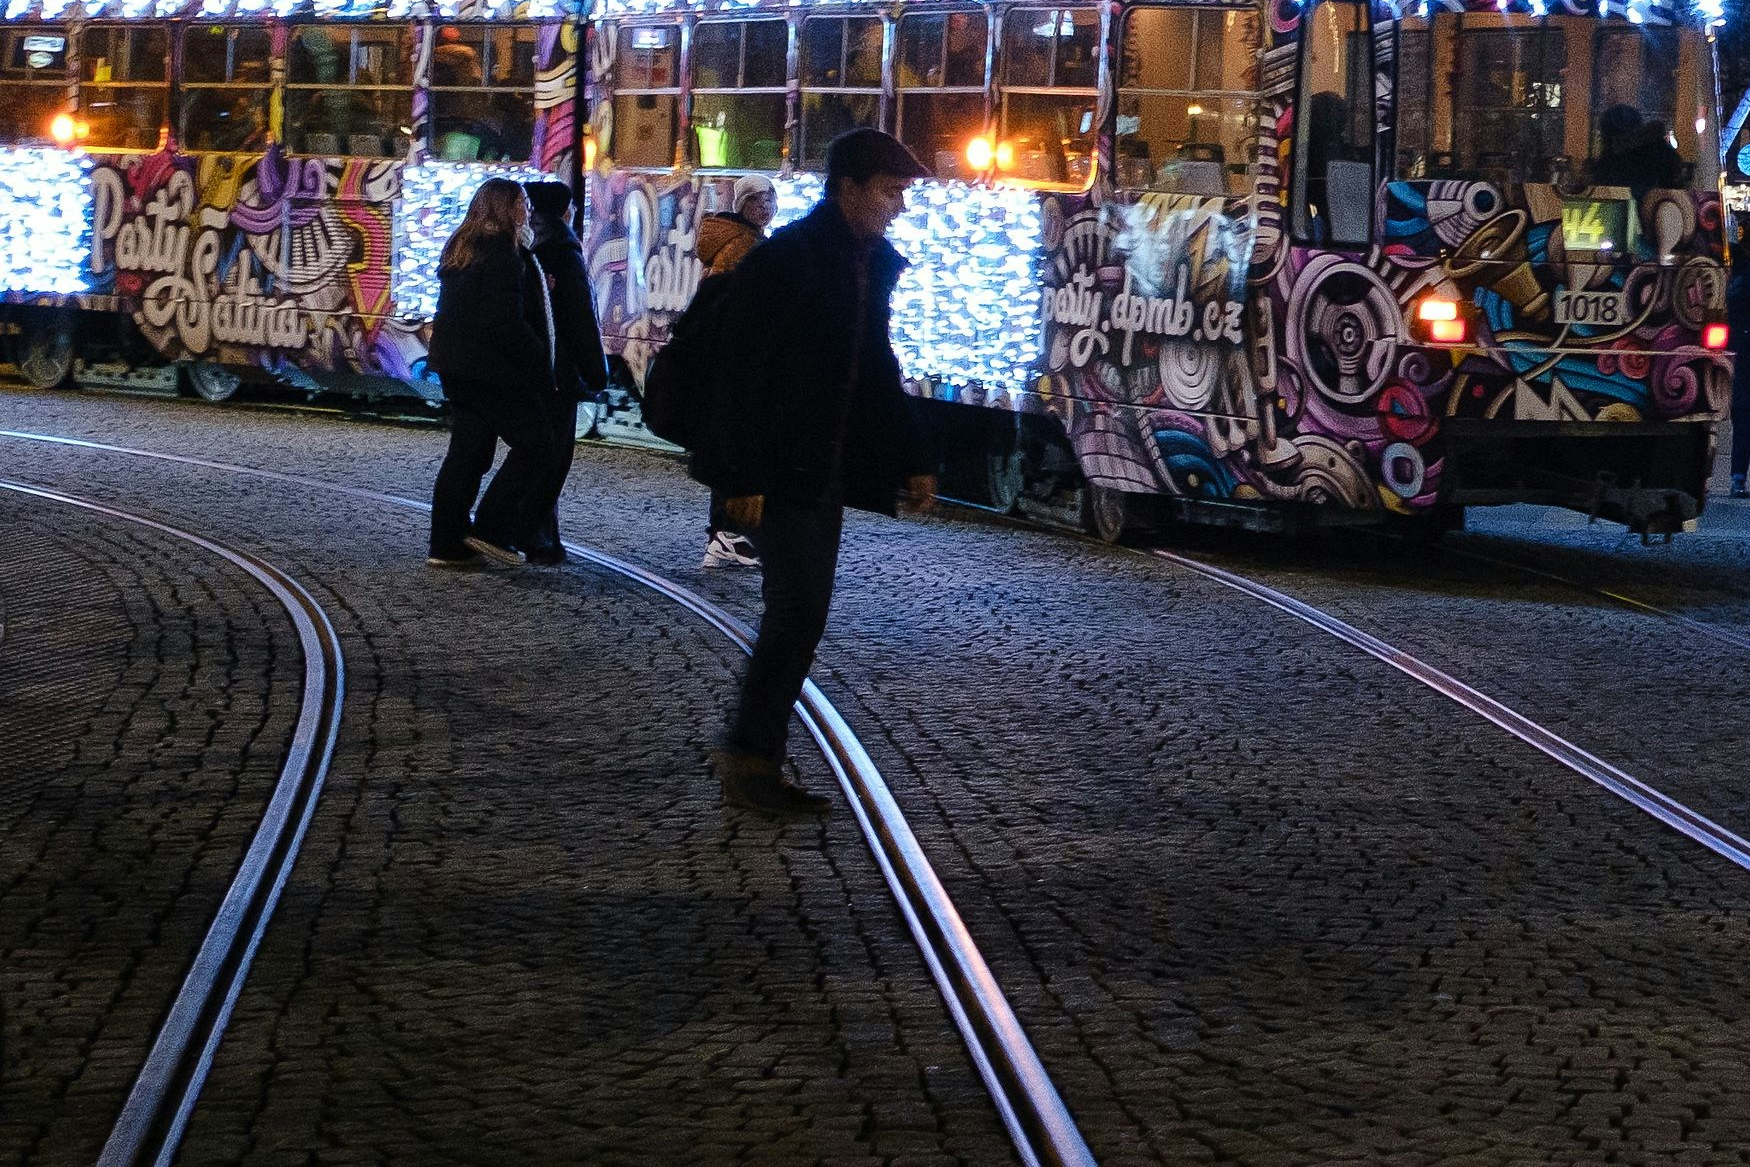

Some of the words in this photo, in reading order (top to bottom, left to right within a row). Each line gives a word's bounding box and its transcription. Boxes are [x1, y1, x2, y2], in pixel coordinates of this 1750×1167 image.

[91, 166, 191, 278] Party
[1039, 263, 1244, 368] party.dpmb.cz
[1560, 294, 1619, 322] 1018
